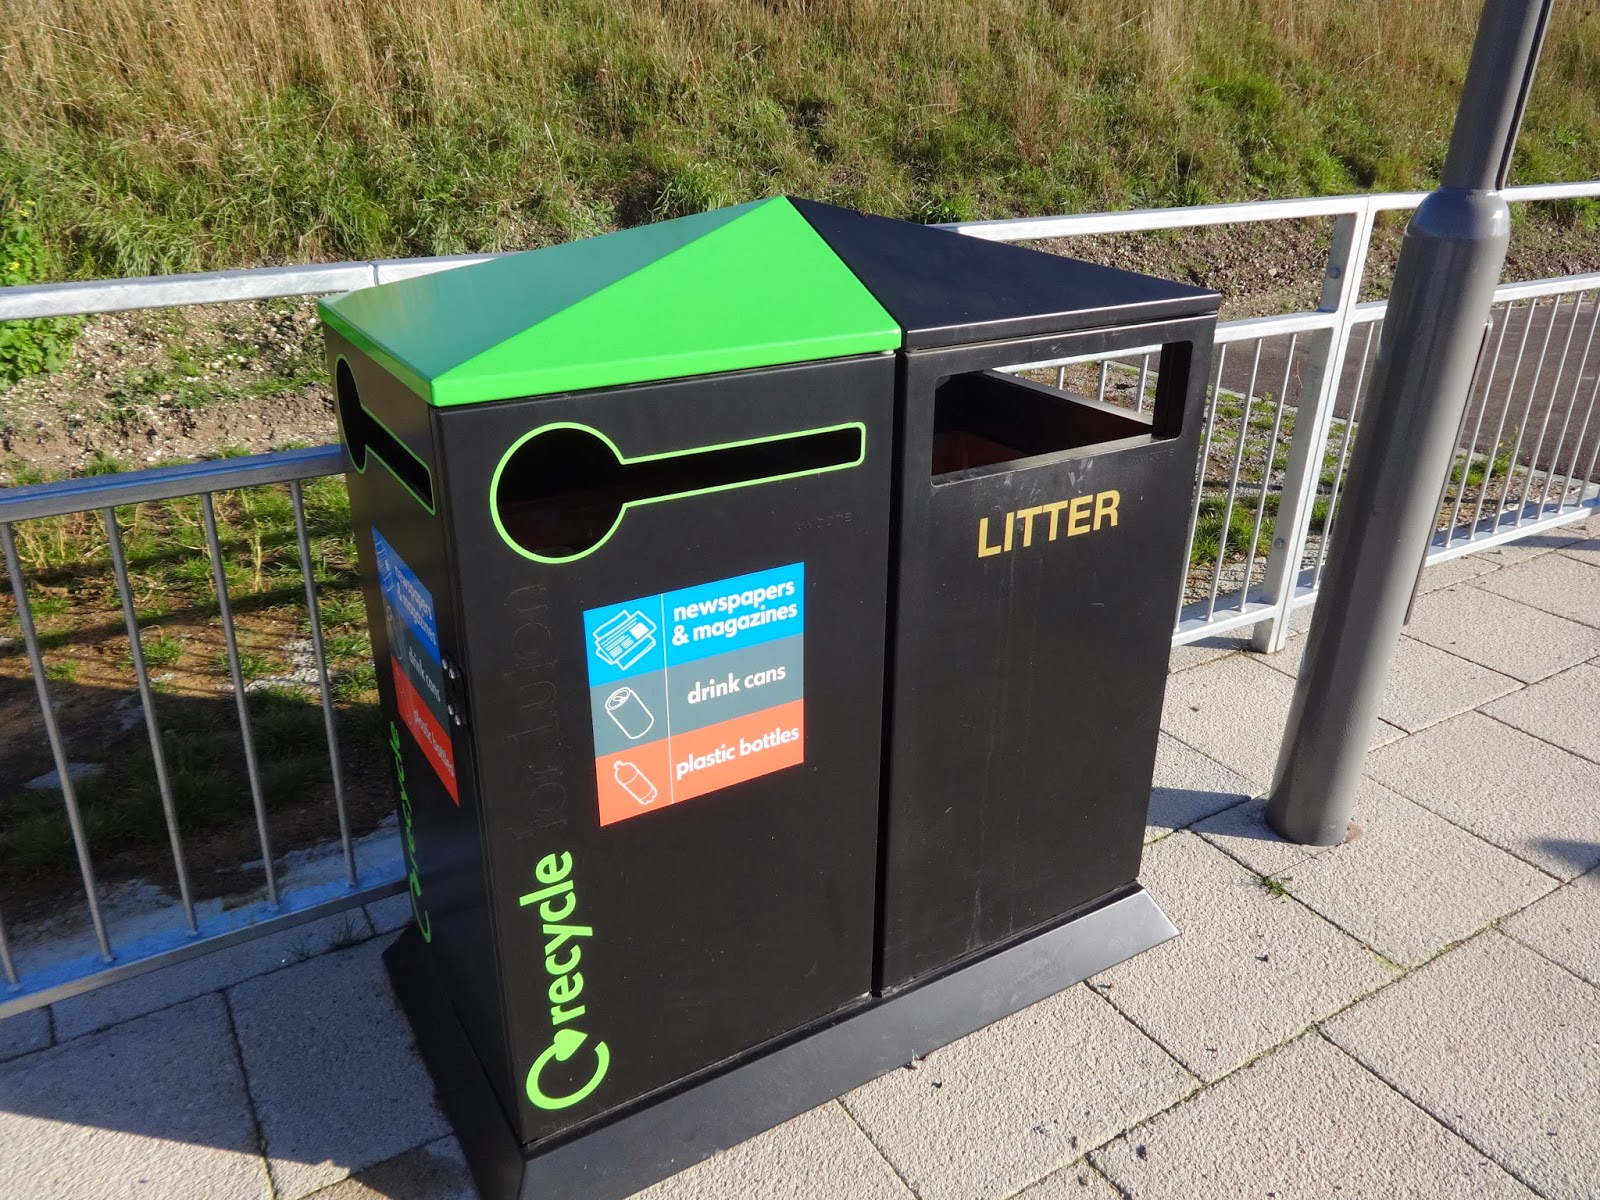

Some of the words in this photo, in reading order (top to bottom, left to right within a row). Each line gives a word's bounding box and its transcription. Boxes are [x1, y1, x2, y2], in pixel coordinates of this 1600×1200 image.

[977, 489, 1121, 559] LITTER
[394, 566, 433, 620] newspapers
[673, 580, 795, 622] newspapers
[671, 624, 690, 647] &
[692, 603, 798, 641] magazines
[408, 645, 425, 683] drink
[425, 672, 441, 703] cans
[687, 672, 741, 705] drink
[744, 666, 787, 688] cans
[675, 744, 736, 781] plastic
[739, 726, 800, 757] bottles
[519, 850, 594, 1026] recycle
